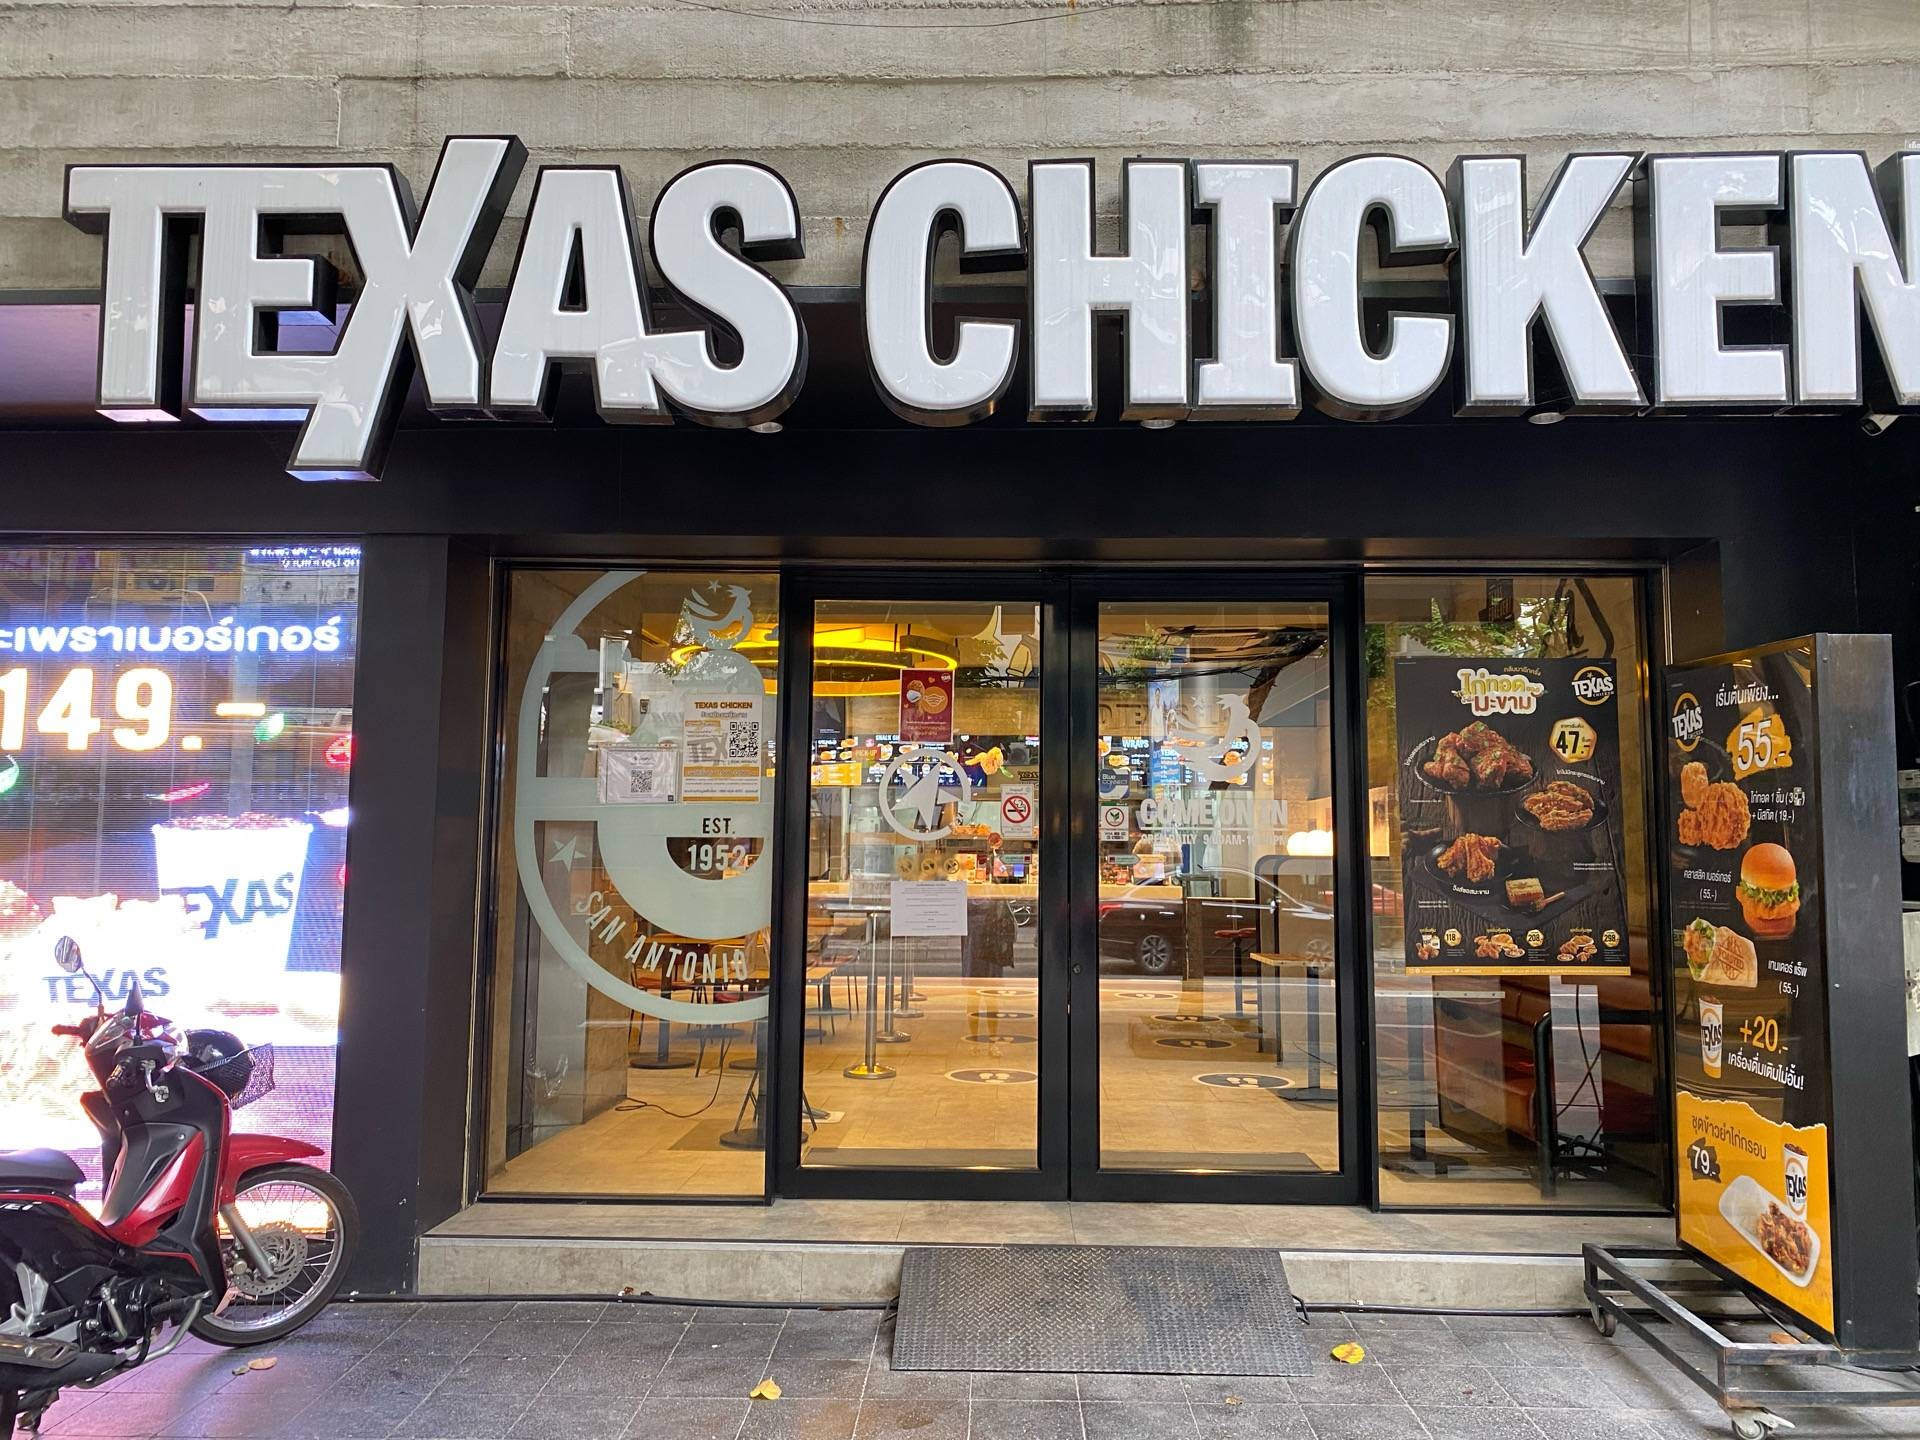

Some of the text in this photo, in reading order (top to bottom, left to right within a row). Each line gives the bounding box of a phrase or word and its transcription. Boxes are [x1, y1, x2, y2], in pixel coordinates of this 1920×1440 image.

[64, 134, 1920, 482] TEXAS CHICKEN
[1460, 672, 1527, 697] ไก่ทอด
[1572, 676, 1614, 698] TEXAS
[694, 701, 753, 709] TEXAS CHICKEN
[1474, 695, 1532, 712] มะขาม
[1672, 707, 1703, 740] TEXAS
[1122, 739, 1150, 748] WRAPS
[1750, 790, 1769, 803] ไก่ทอด
[1775, 788, 1785, 804] ชิ้น
[1140, 799, 1214, 824] COME
[1220, 799, 1250, 825] ON
[702, 817, 736, 834] EST.
[688, 844, 746, 871] 1952
[575, 891, 749, 984] SAN ANTONIO
[42, 967, 171, 1008] TEXAS
[1701, 1024, 1722, 1051] TEXAS
[1691, 1115, 1767, 1160] ชุดข้าวยำไก่กรอบ
[1785, 1174, 1807, 1203] TEXAS
